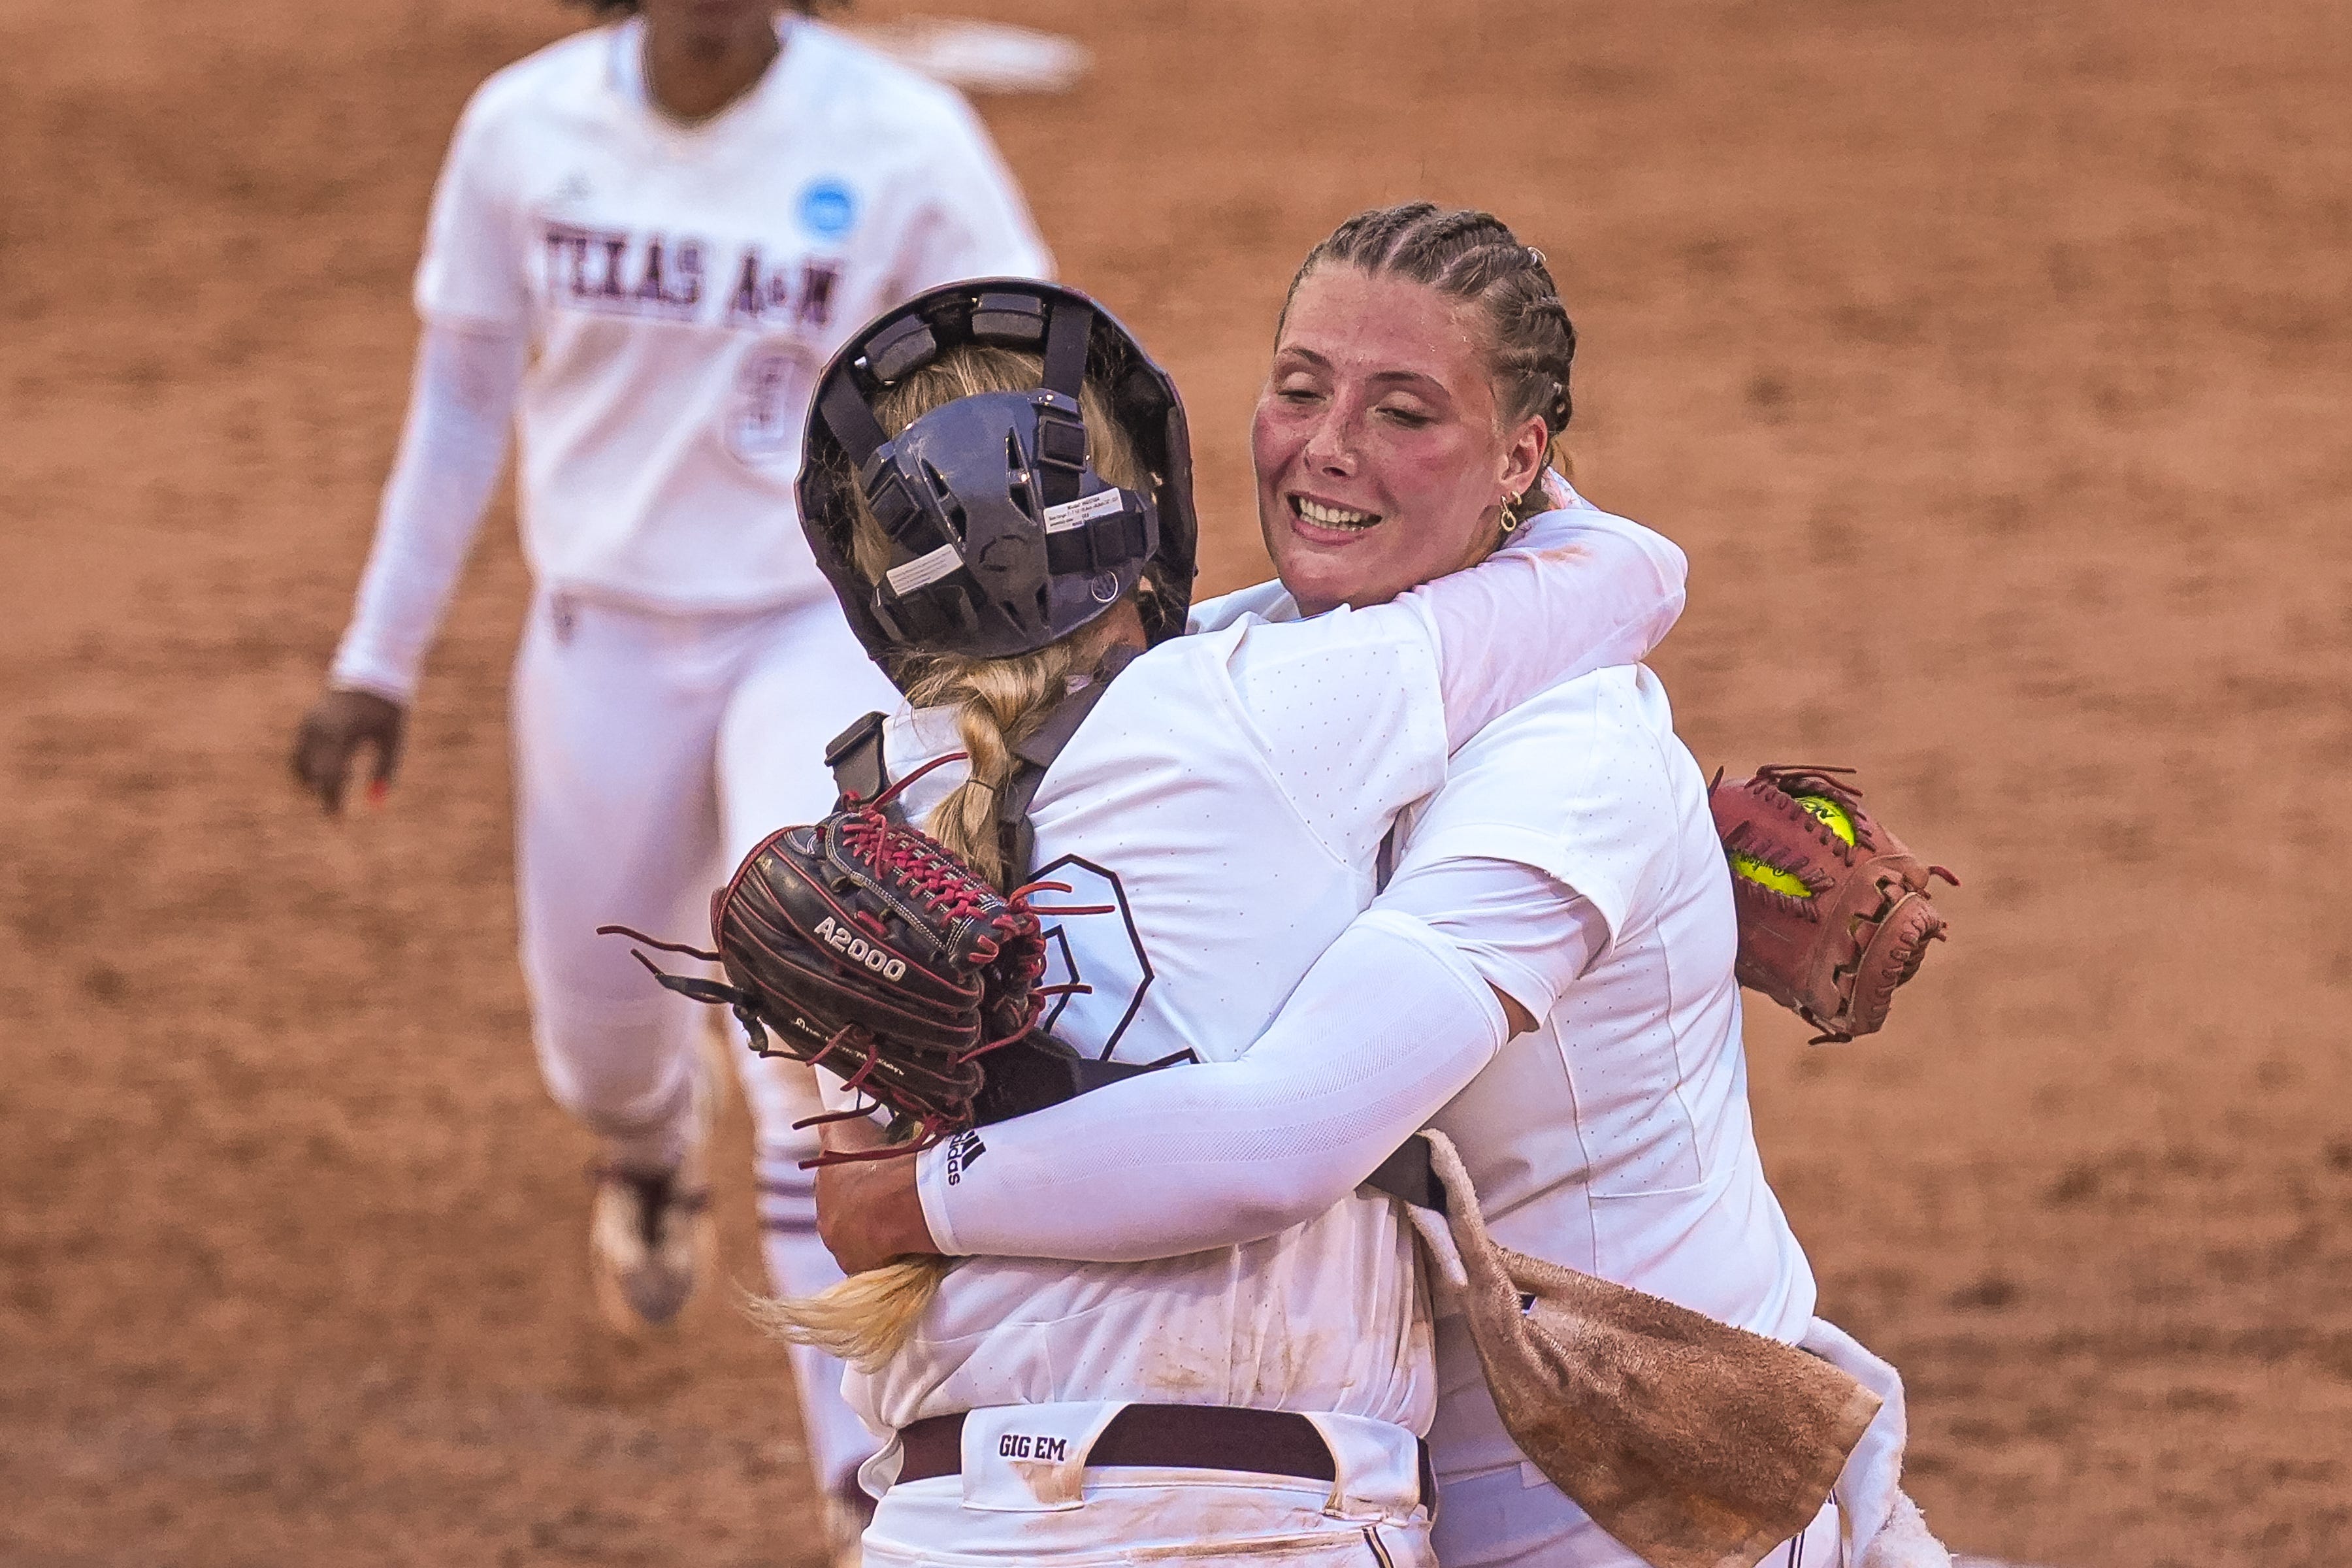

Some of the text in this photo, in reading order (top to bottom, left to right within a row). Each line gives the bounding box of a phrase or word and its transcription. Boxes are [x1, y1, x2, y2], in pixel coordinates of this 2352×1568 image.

[814, 916, 906, 982] A2000
[947, 1134, 962, 1186] didas
[999, 1434, 1067, 1462] GIG EM
